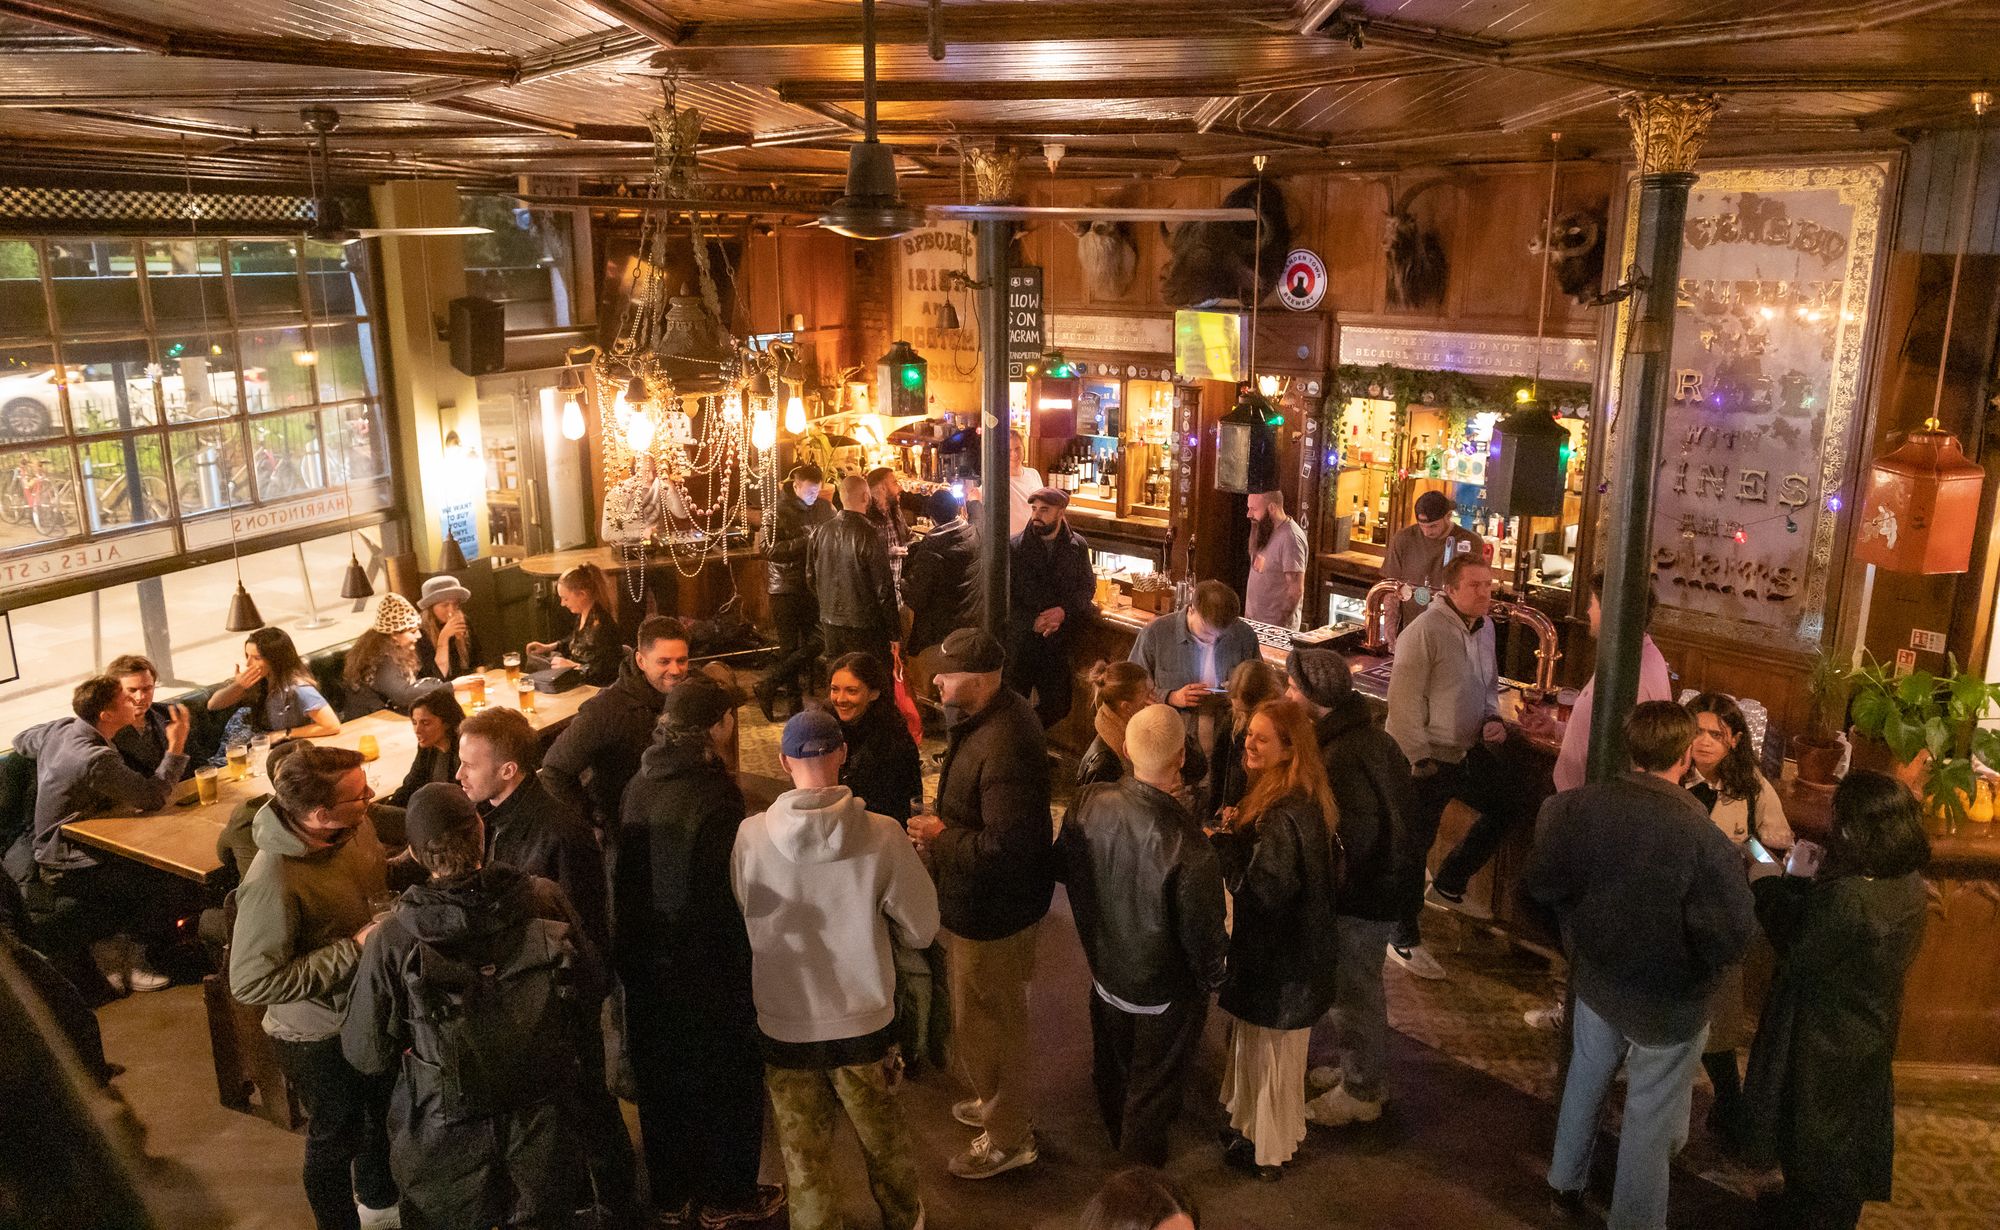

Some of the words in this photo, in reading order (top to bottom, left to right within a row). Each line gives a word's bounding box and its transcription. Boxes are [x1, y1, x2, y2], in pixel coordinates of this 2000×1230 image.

[1010, 293, 1039, 309] LLOW
[1284, 291, 1314, 306] BREWERY
[1016, 312, 1036, 327] ON
[1469, 341, 1487, 351] DO
[1492, 343, 1521, 353] NOT
[1415, 352, 1441, 362] THE
[1445, 354, 1502, 367] MUTTON
[1509, 359, 1523, 368] IS
[1661, 460, 1809, 507] INES
